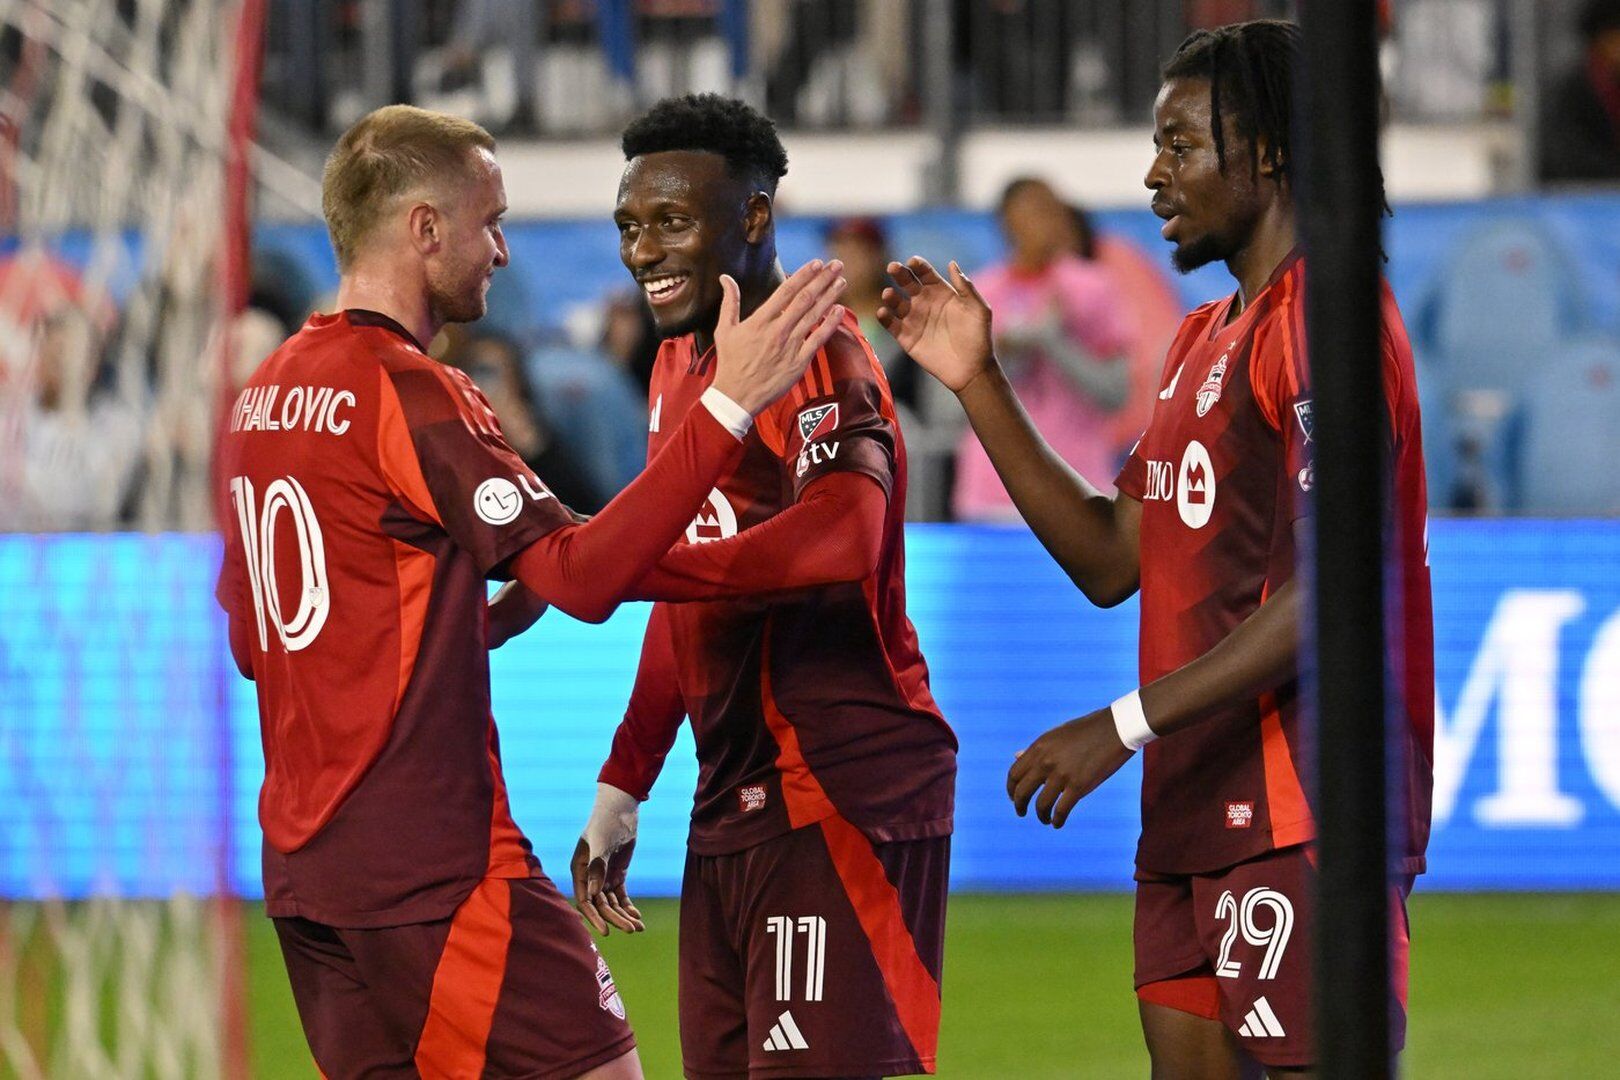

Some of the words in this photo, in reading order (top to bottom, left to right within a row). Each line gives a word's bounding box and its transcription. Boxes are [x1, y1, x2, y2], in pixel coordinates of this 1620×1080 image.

[801, 410, 823, 424] MLS
[809, 441, 840, 464] tv
[230, 475, 330, 653] 10
[767, 916, 826, 1001] 11
[1215, 886, 1294, 980] 29
